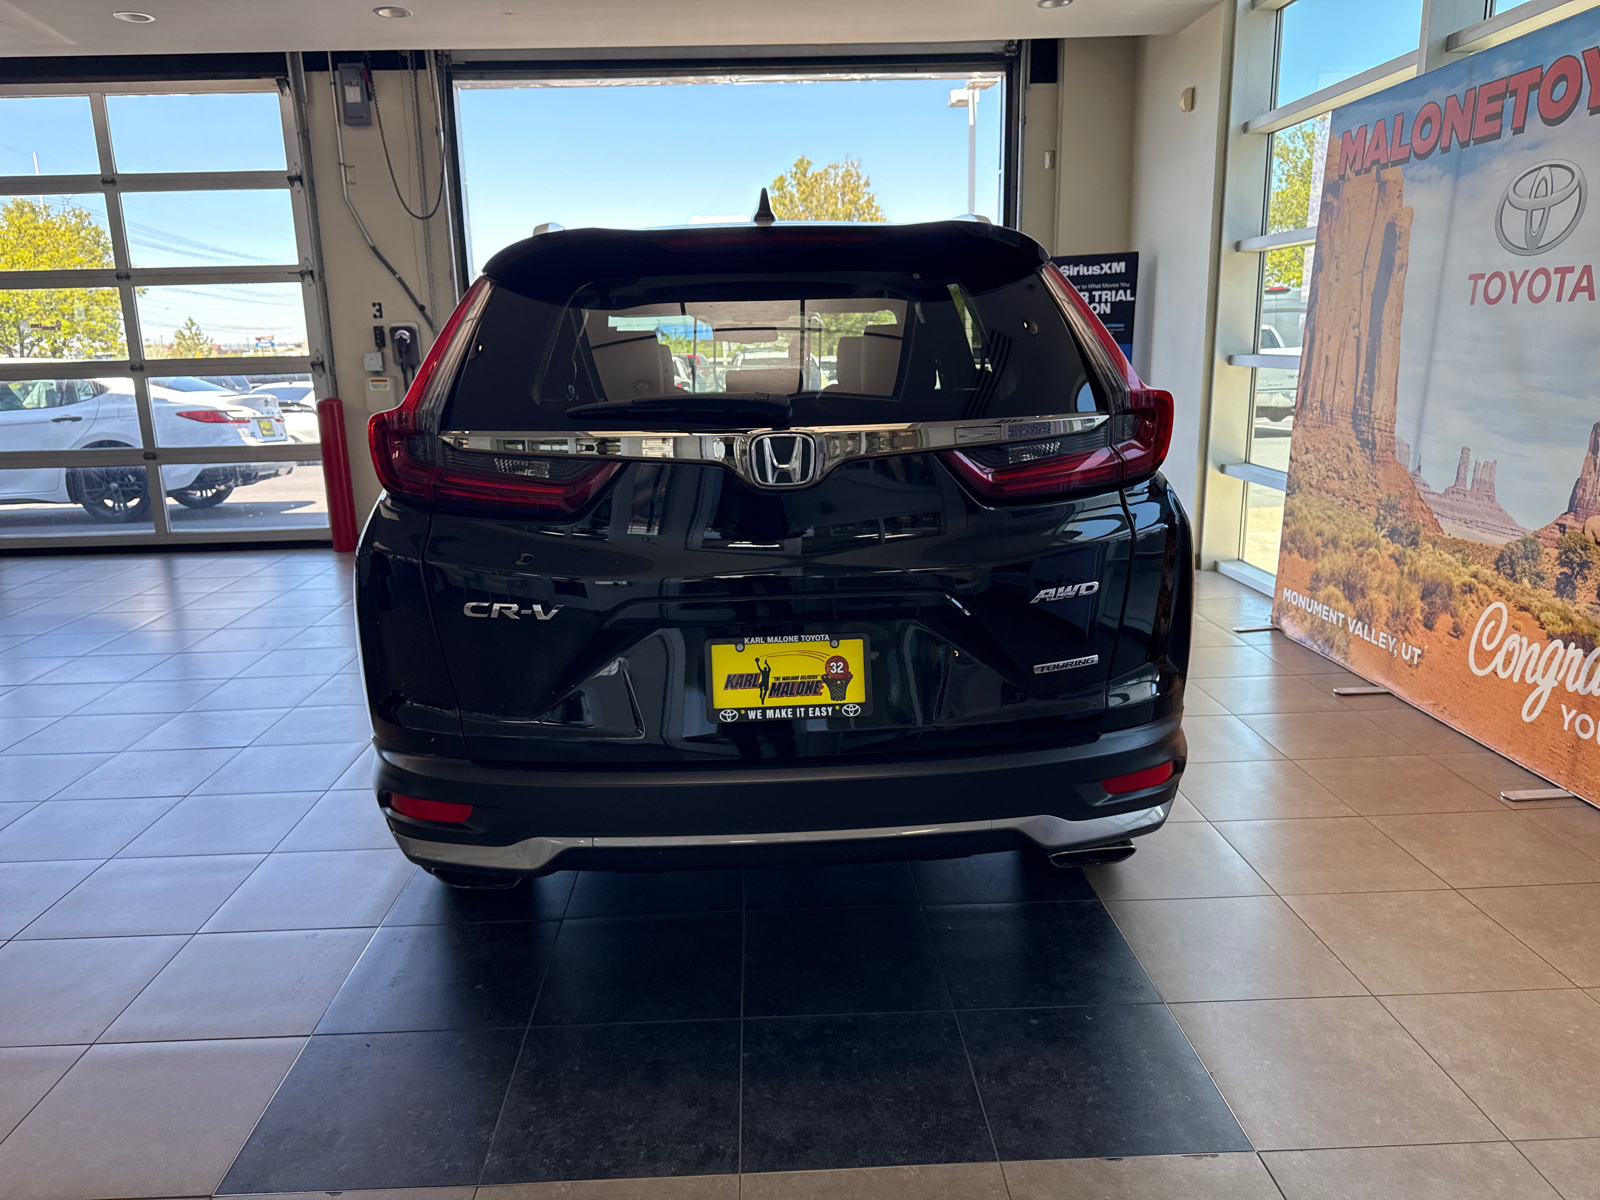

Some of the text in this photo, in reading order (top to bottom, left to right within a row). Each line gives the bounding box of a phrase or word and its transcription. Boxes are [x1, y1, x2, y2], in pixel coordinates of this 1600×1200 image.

[1060, 262, 1126, 276] SiriusXM
[1467, 264, 1596, 306] TOYOTA
[1092, 290, 1135, 302] TRIAL
[372, 303, 383, 319] 3
[1030, 581, 1099, 604] AWD
[463, 602, 565, 620] CR-V
[1283, 587, 1422, 666] MONUMENT VALLEY, UT
[767, 635, 799, 643] MALONE
[801, 634, 830, 642] TOYOTA
[830, 662, 844, 673] 32
[1039, 656, 1096, 672] TOURING
[724, 673, 761, 690] KARL
[768, 680, 824, 698] MALONE
[748, 706, 833, 719] WE MAKE IT EASY
[1561, 704, 1600, 746] YO
